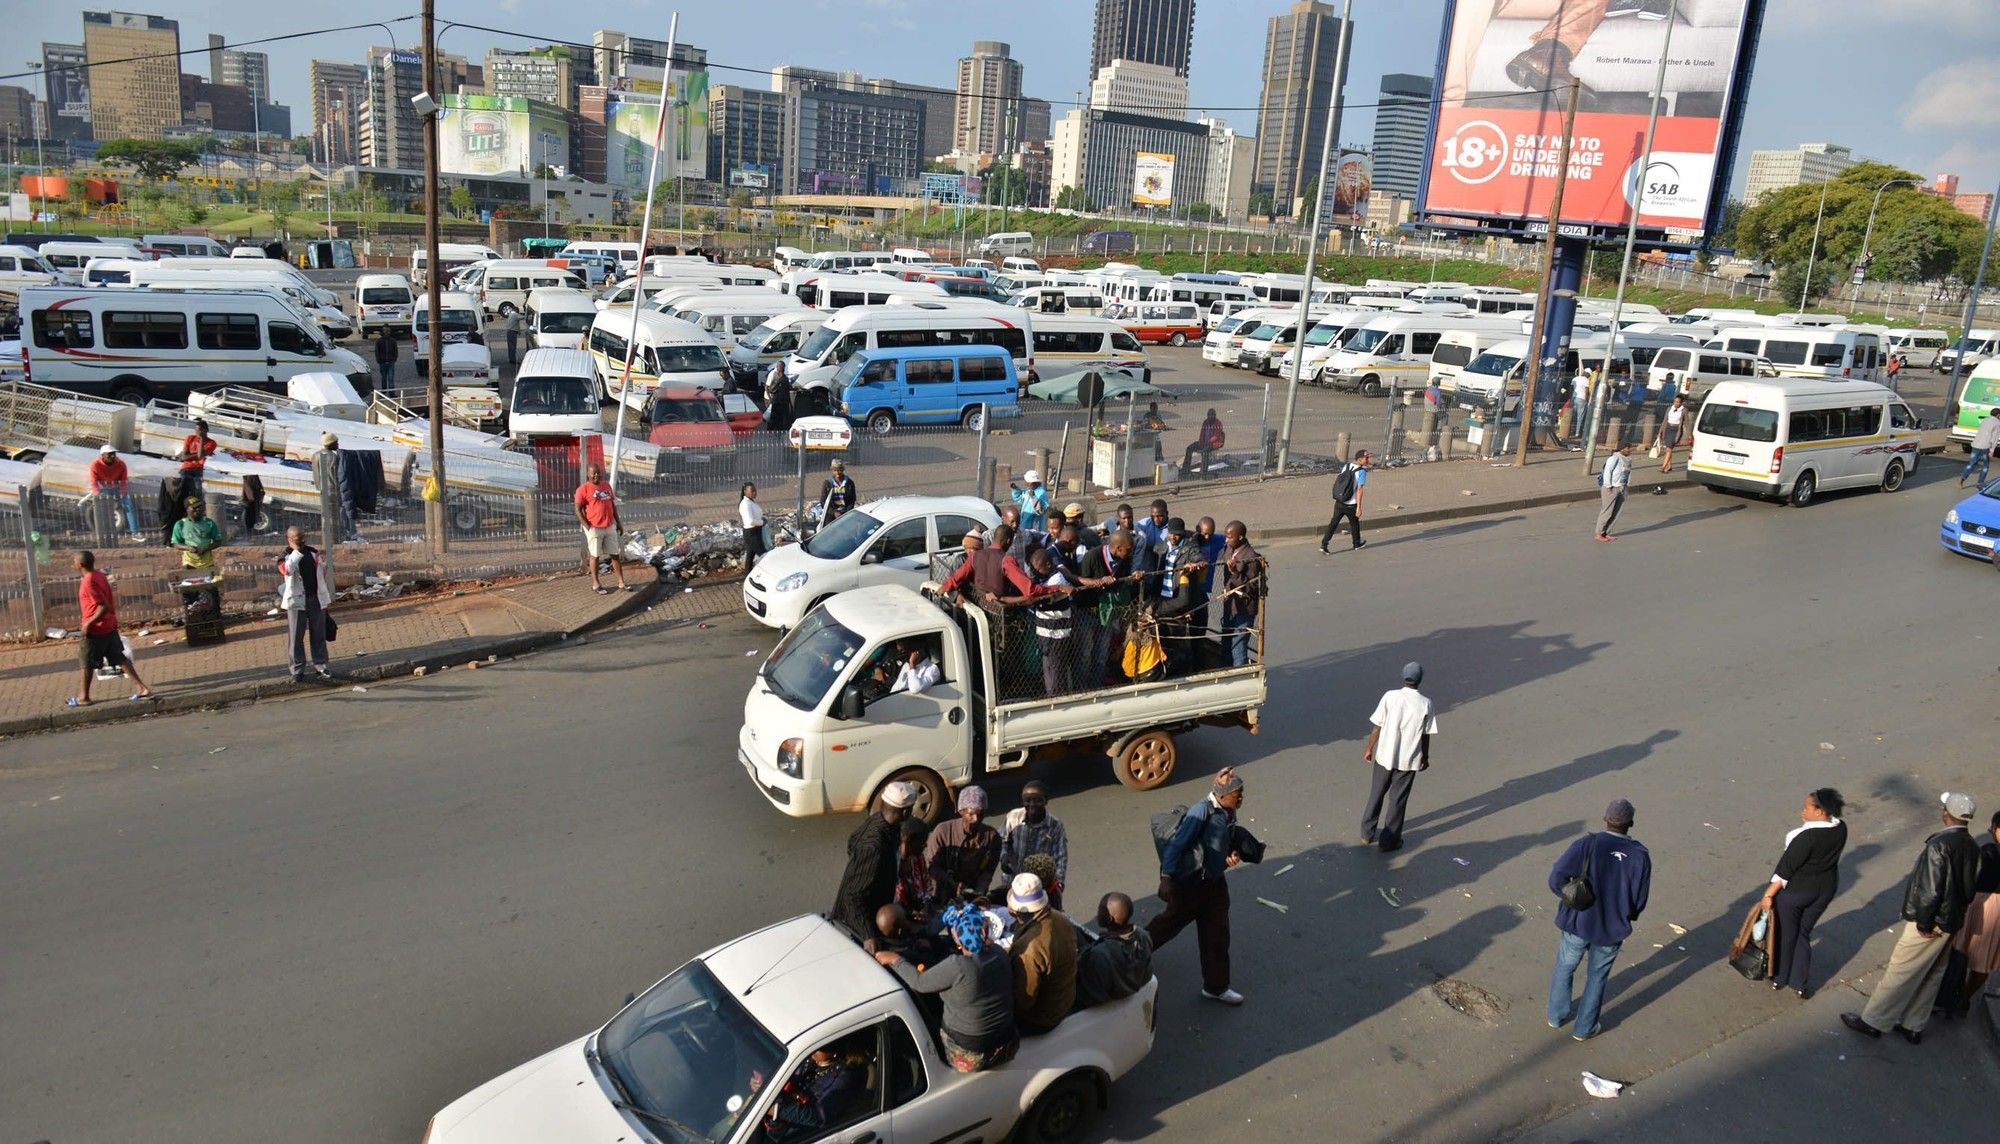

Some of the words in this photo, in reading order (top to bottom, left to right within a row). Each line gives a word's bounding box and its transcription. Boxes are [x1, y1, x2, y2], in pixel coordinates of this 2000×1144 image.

[1596, 56, 1620, 64] Robert
[1623, 57, 1652, 65] Marawa
[1658, 58, 1682, 66] Fther
[1693, 59, 1715, 67] Uncle
[468, 132, 501, 151] LITE
[1515, 134, 1547, 149] SAY
[1579, 136, 1601, 151] TO
[1441, 136, 1501, 169] 18+
[1512, 149, 1604, 167] UNDEAGE
[1510, 162, 1592, 181] DRINKNG
[1647, 182, 1679, 195] SAB
[1529, 223, 1583, 235] PRIEDIA
